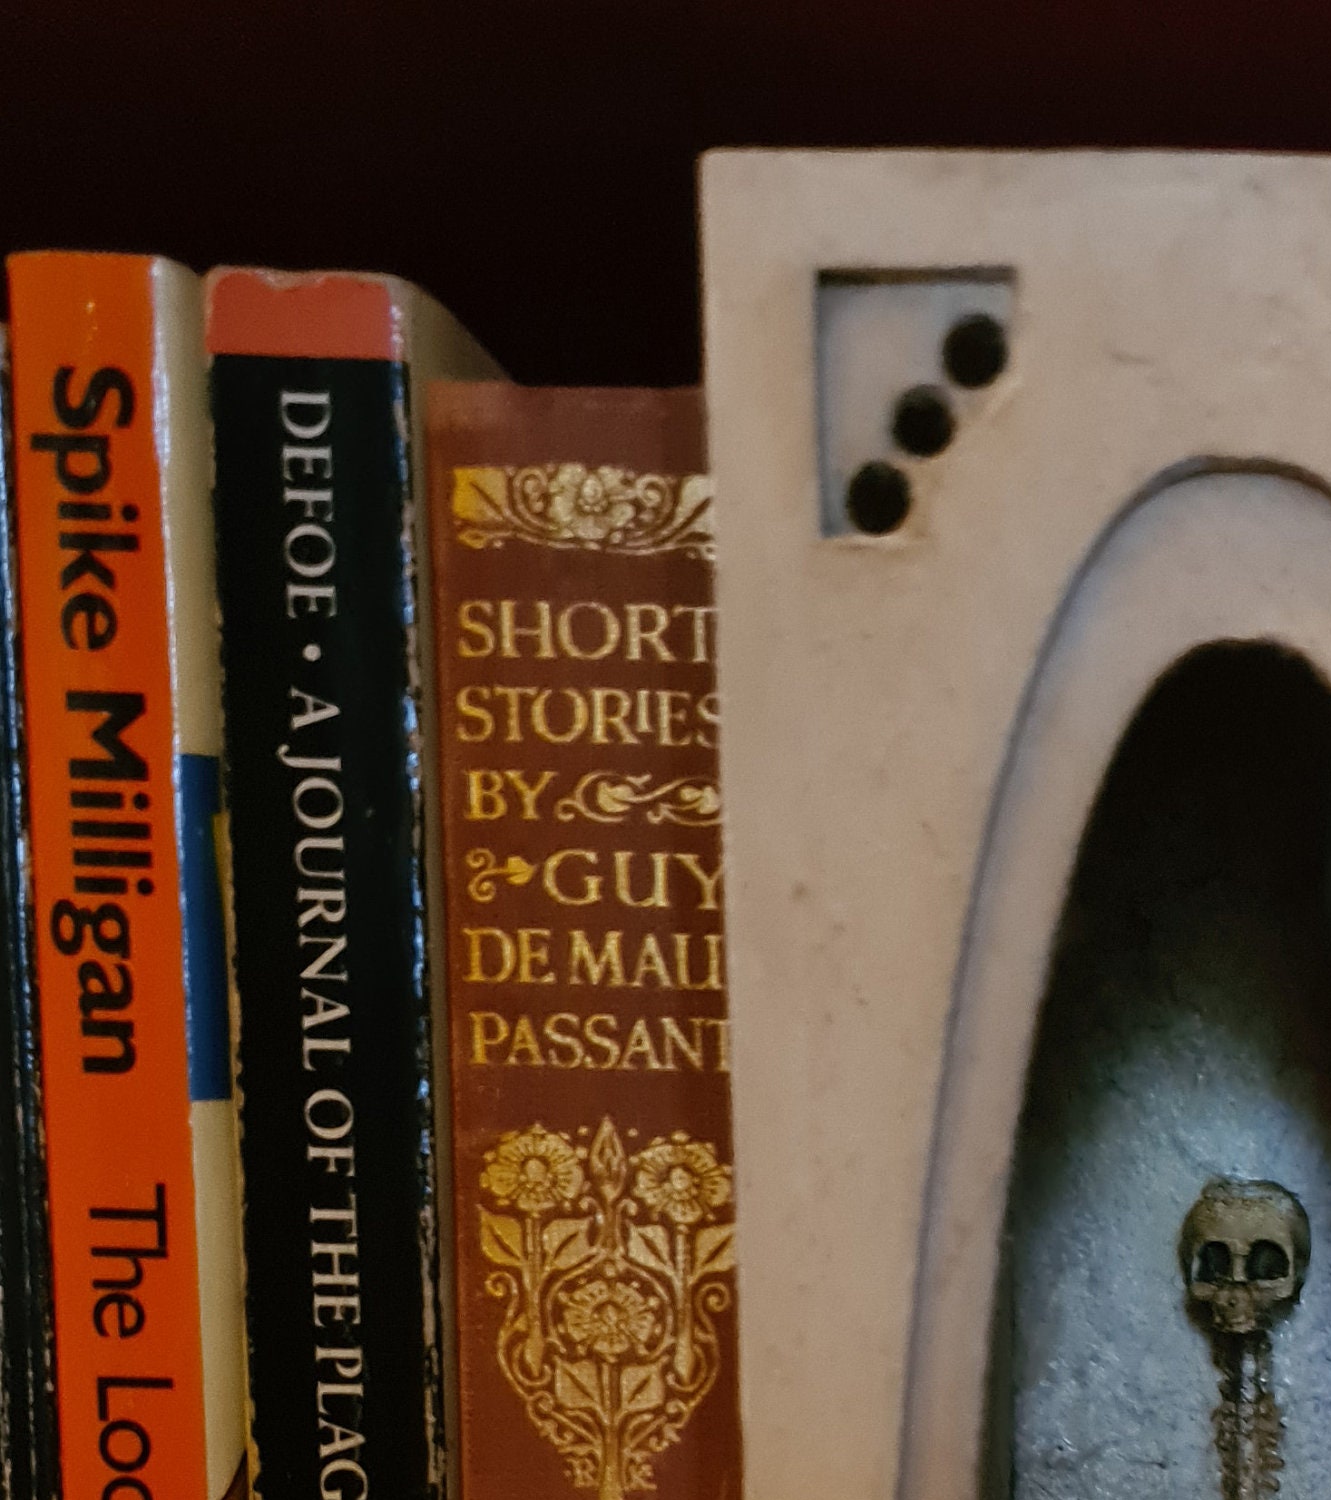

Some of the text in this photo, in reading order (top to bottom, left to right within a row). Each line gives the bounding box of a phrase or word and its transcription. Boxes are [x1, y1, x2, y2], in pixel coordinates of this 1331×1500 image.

[29, 365, 137, 652] Spike
[279, 389, 338, 619] DEFOE
[457, 599, 719, 664] SHORT
[290, 687, 341, 730] A
[454, 686, 722, 750] STORIES
[464, 768, 557, 822] BY
[50, 690, 155, 1076] Milligan
[277, 744, 353, 1071] JOURNAL
[541, 847, 724, 910] GUY
[461, 926, 556, 985] DE
[468, 1010, 732, 1071] PASSANT
[303, 1088, 356, 1174] OF
[88, 1183, 169, 1339] The
[308, 1192, 362, 1328] THE
